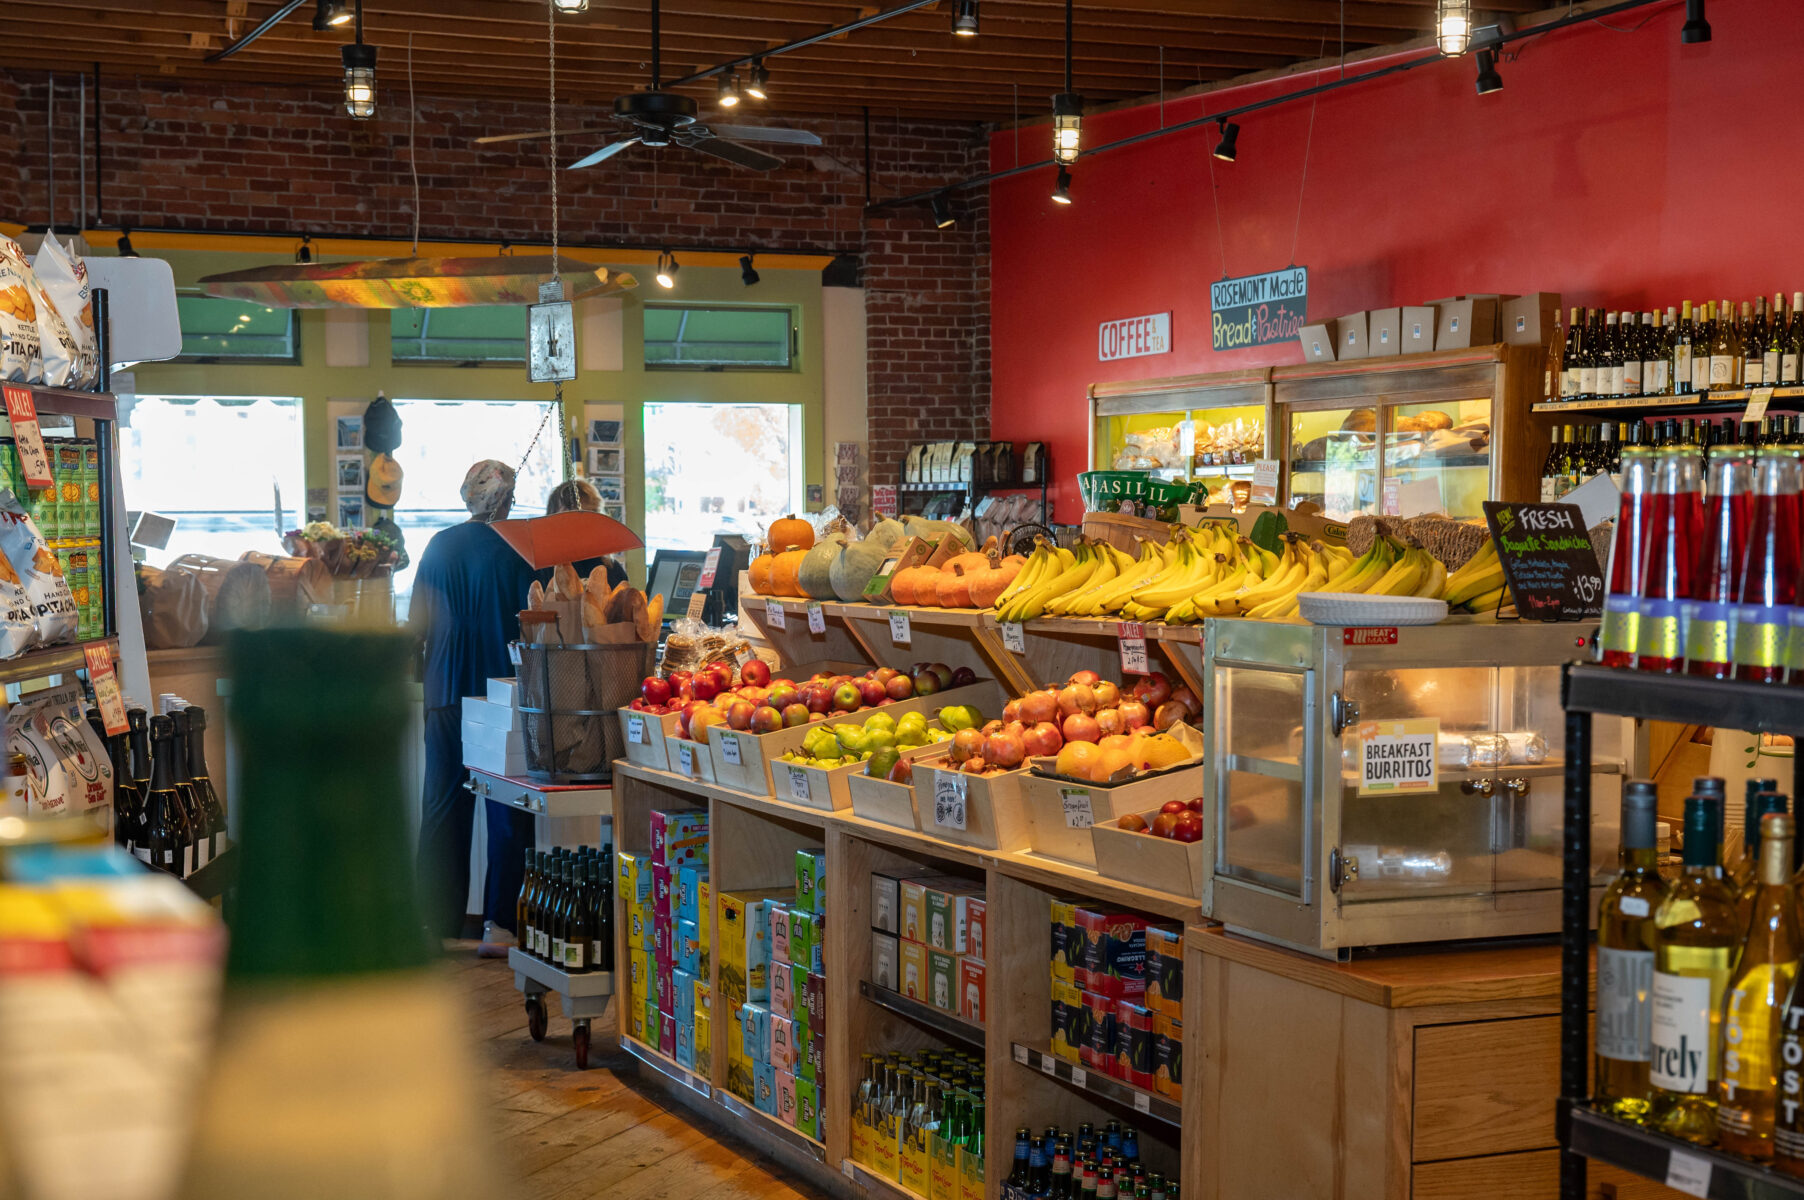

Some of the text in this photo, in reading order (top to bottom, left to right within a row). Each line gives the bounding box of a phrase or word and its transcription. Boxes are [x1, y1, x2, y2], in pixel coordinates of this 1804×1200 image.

[1214, 271, 1304, 309] ROSEMONT Made
[1101, 317, 1151, 359] COFFEE
[1213, 308, 1251, 348] Bread
[1252, 315, 1257, 339] &
[1152, 335, 1165, 352] TEA
[9, 390, 32, 417] SALE!
[1256, 463, 1276, 472] PLEASE
[1519, 507, 1574, 530] FRESH
[1122, 623, 1140, 638] SALE!
[1367, 636, 1389, 644] MAX
[1368, 628, 1389, 638] HEAT
[1366, 742, 1432, 760] BREAKFAST
[1366, 759, 1432, 780] BURRITOS
[1783, 1006, 1804, 1124] TÖST
